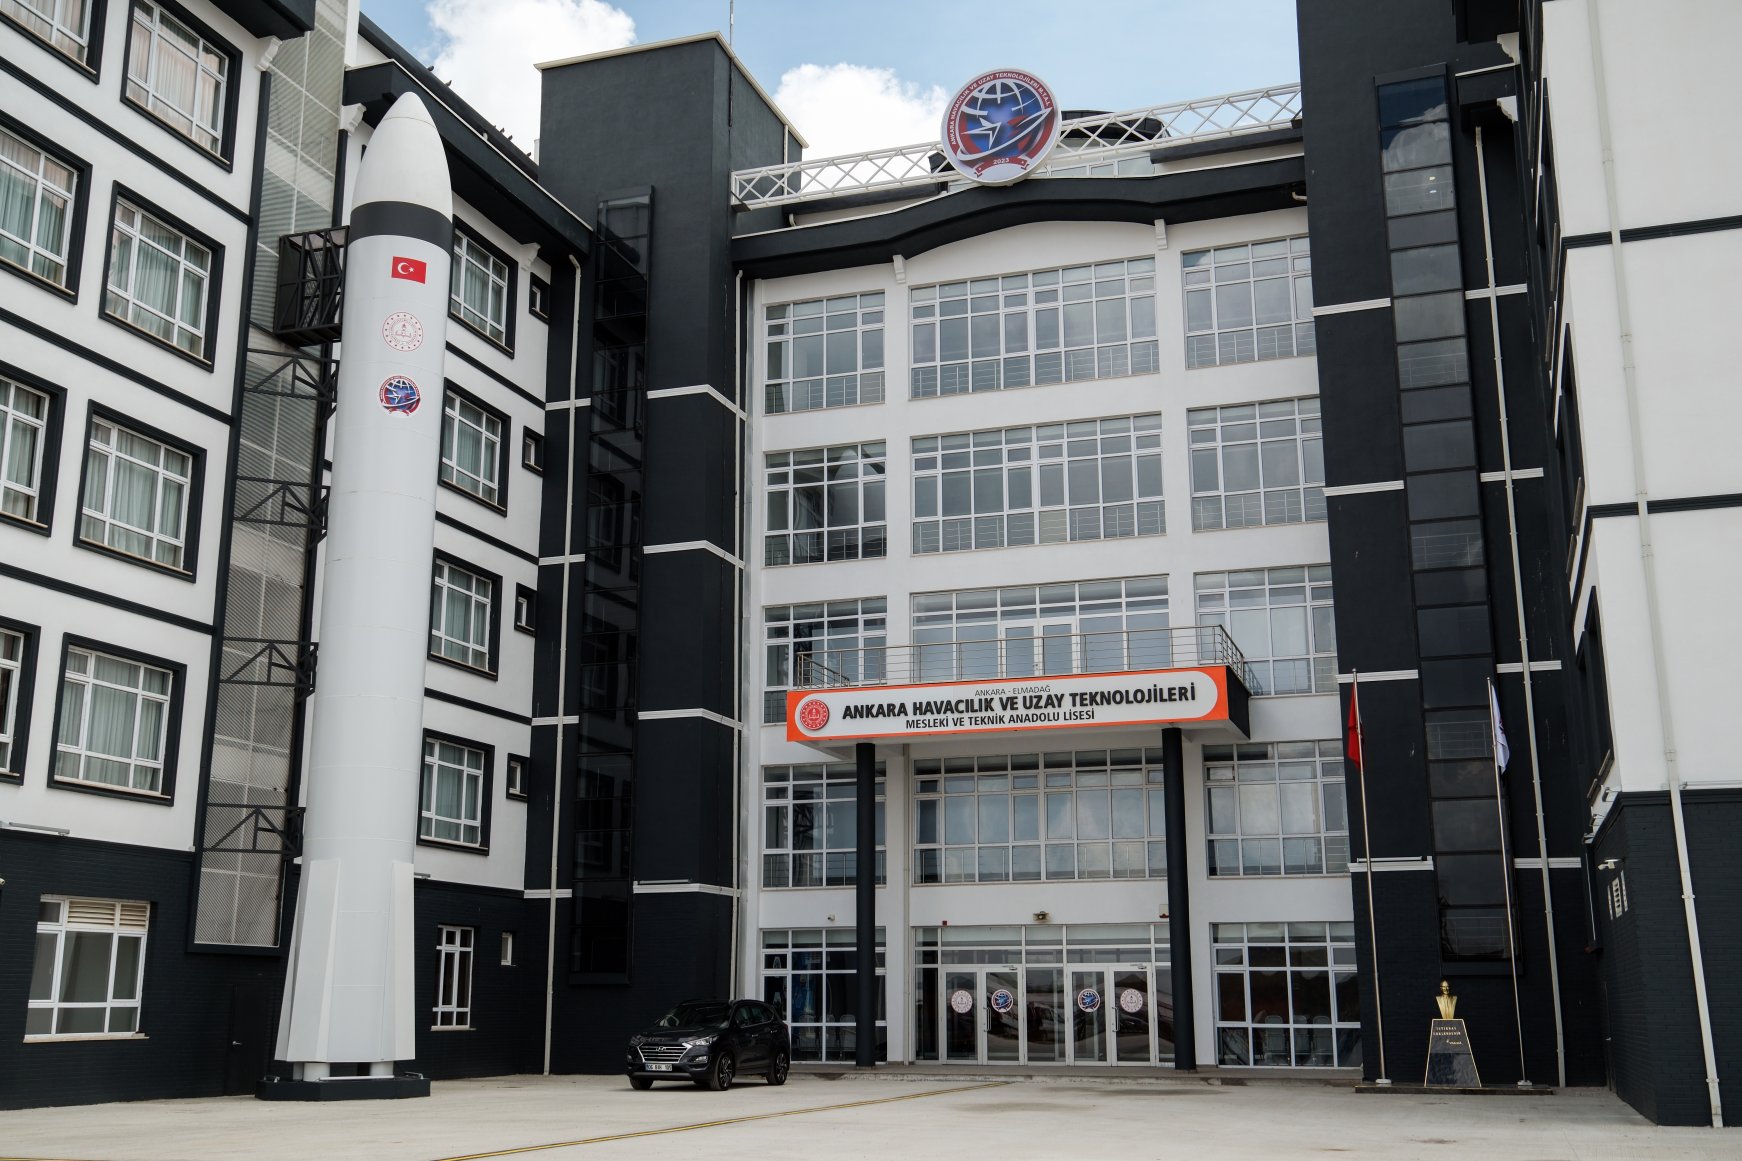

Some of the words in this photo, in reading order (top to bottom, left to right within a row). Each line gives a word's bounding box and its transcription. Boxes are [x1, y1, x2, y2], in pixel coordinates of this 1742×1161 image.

[969, 82, 978, 91] VE
[978, 74, 994, 85] UZAY
[992, 157, 1010, 165] 2023
[975, 688, 1006, 697] ANKARA
[1012, 684, 1051, 695] ELMADAĞ
[842, 702, 908, 720] ANKARA
[912, 697, 994, 716] HAVACILIK
[998, 695, 1018, 711] VE
[1022, 693, 1065, 710] UZAY
[1069, 682, 1196, 707] TEKNOLOJİLERİ
[906, 715, 949, 729] MESLEKİ
[952, 715, 965, 727] VE
[967, 713, 1006, 726] TEKNİK
[1008, 711, 1060, 724] ANADOLU
[1064, 708, 1095, 721] LİSESİ
